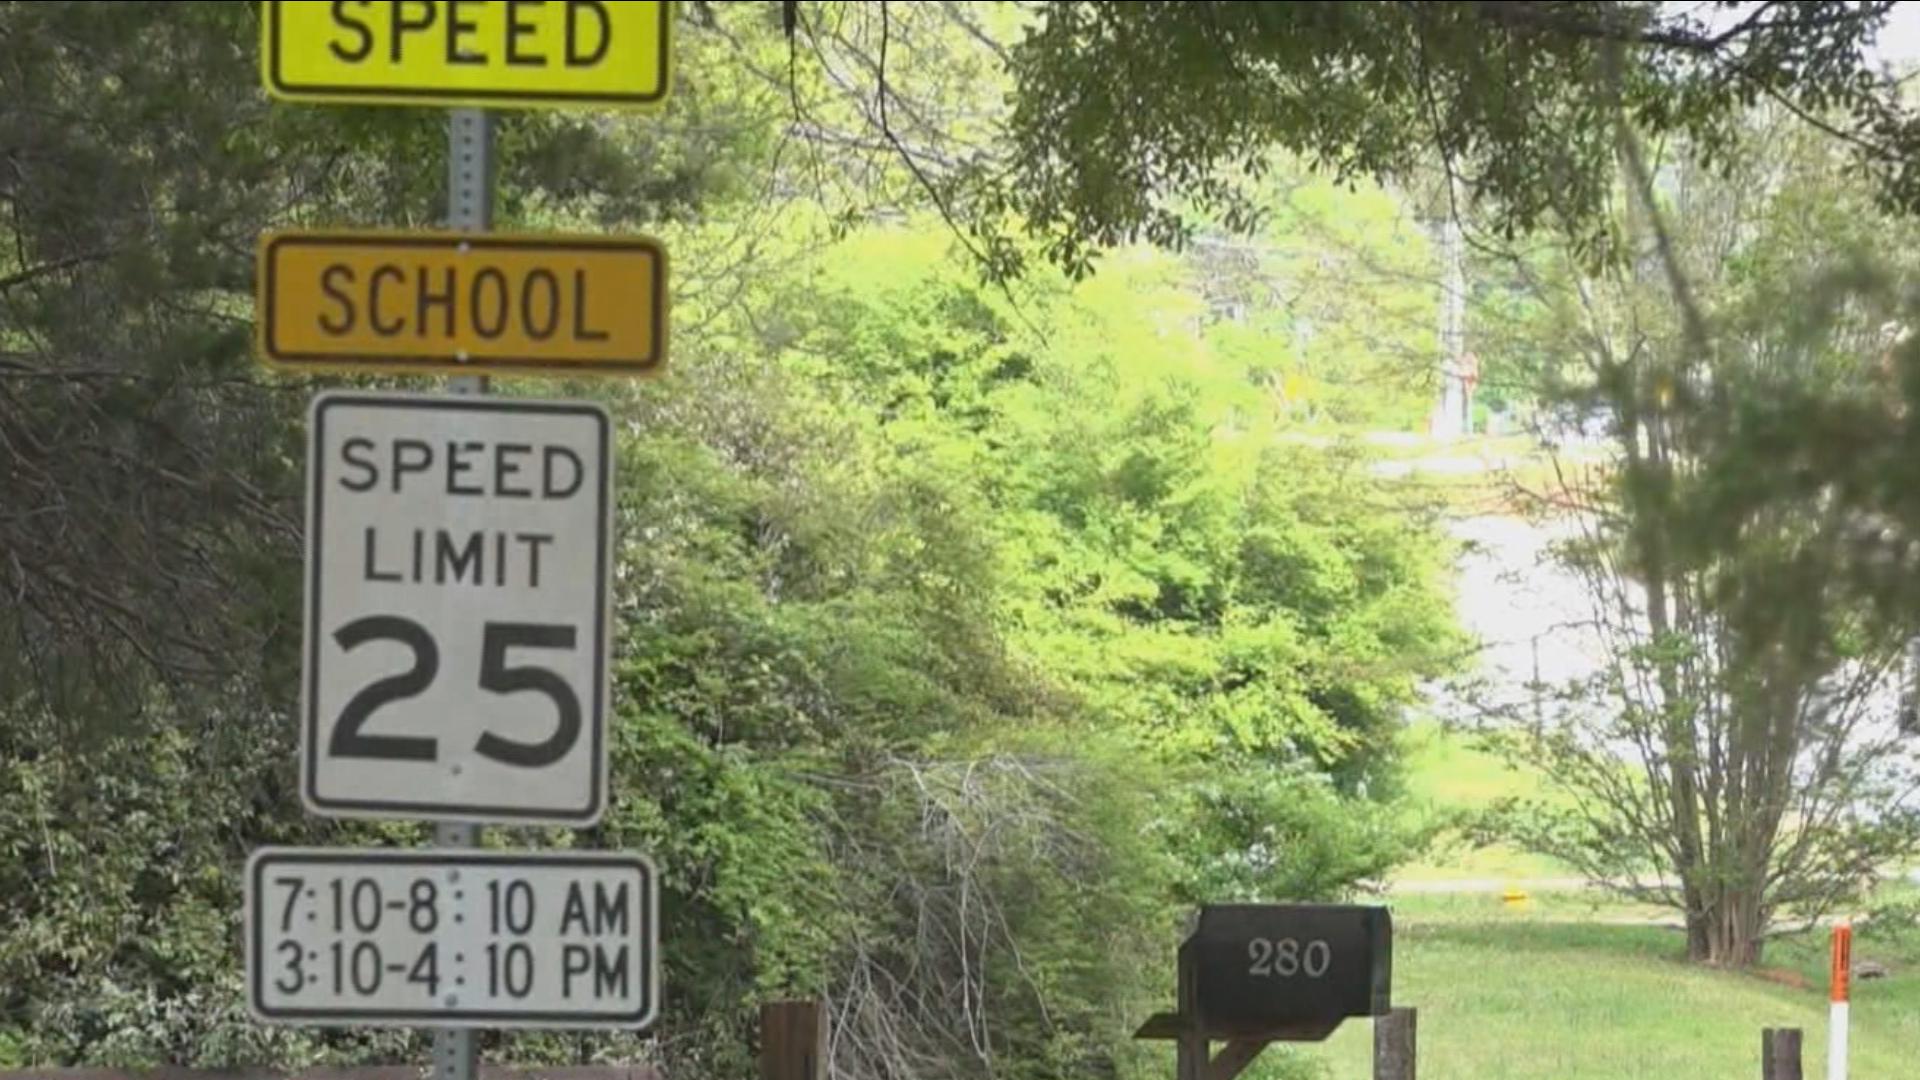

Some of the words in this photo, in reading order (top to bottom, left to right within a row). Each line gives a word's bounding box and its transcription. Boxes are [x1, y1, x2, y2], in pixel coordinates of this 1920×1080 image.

[328, 0, 612, 67] SPEED
[317, 264, 610, 342] SCHOOL
[339, 437, 584, 499] SPEED
[364, 526, 554, 588] LIMIT
[328, 614, 583, 769] 25
[559, 880, 630, 936] AM
[561, 943, 630, 999] PM
[1248, 937, 1331, 977] 280
